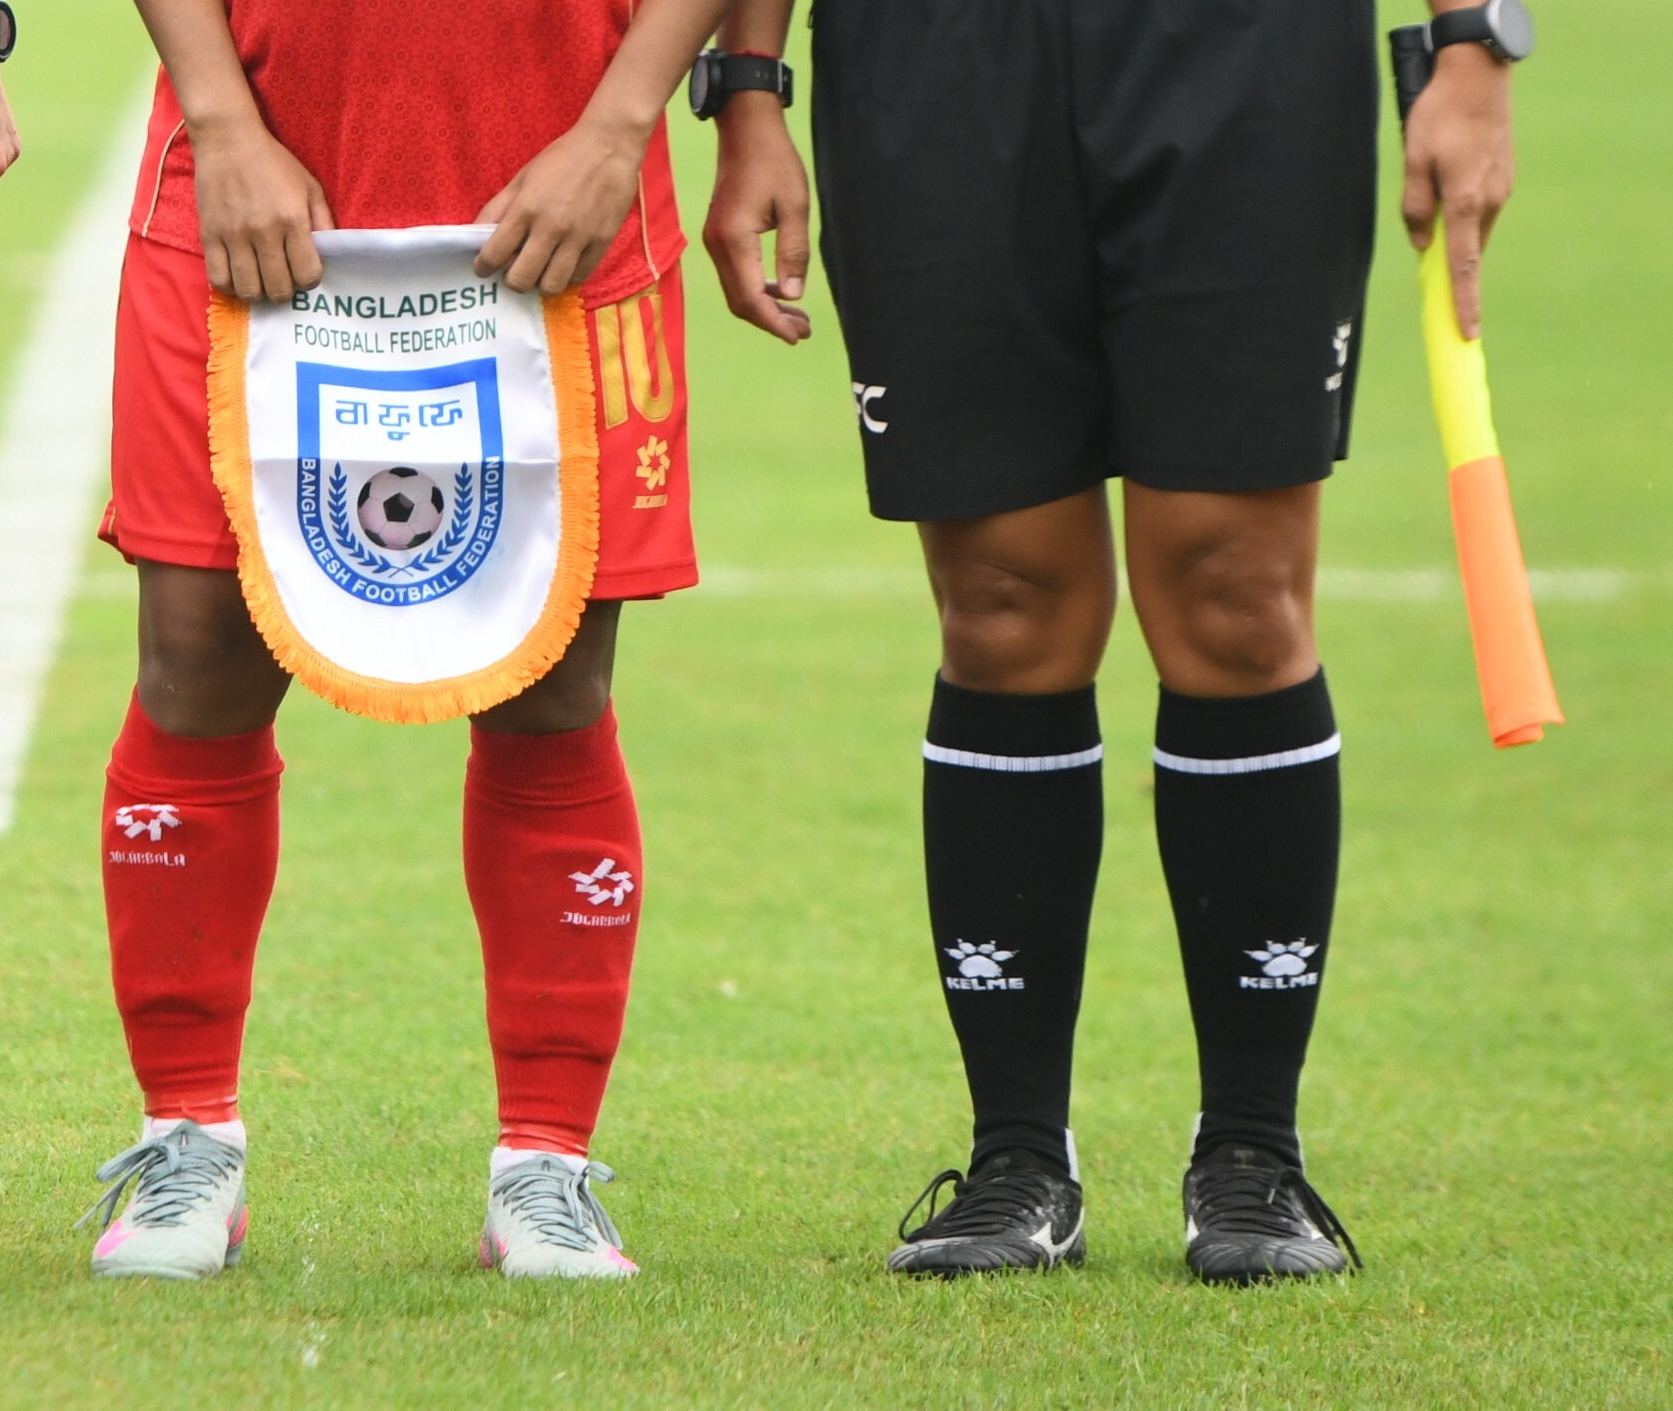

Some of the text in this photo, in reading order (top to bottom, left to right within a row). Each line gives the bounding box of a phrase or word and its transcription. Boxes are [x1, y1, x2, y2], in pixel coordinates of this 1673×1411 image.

[291, 282, 498, 319] BANGLADESH
[294, 317, 497, 354] FOOTBALL FEDERATION
[594, 281, 674, 431] 10
[301, 455, 501, 604] BANGLADESH FOOTBALL FEDERATION
[945, 975, 1026, 991] KELME
[1239, 971, 1319, 990] KELME
